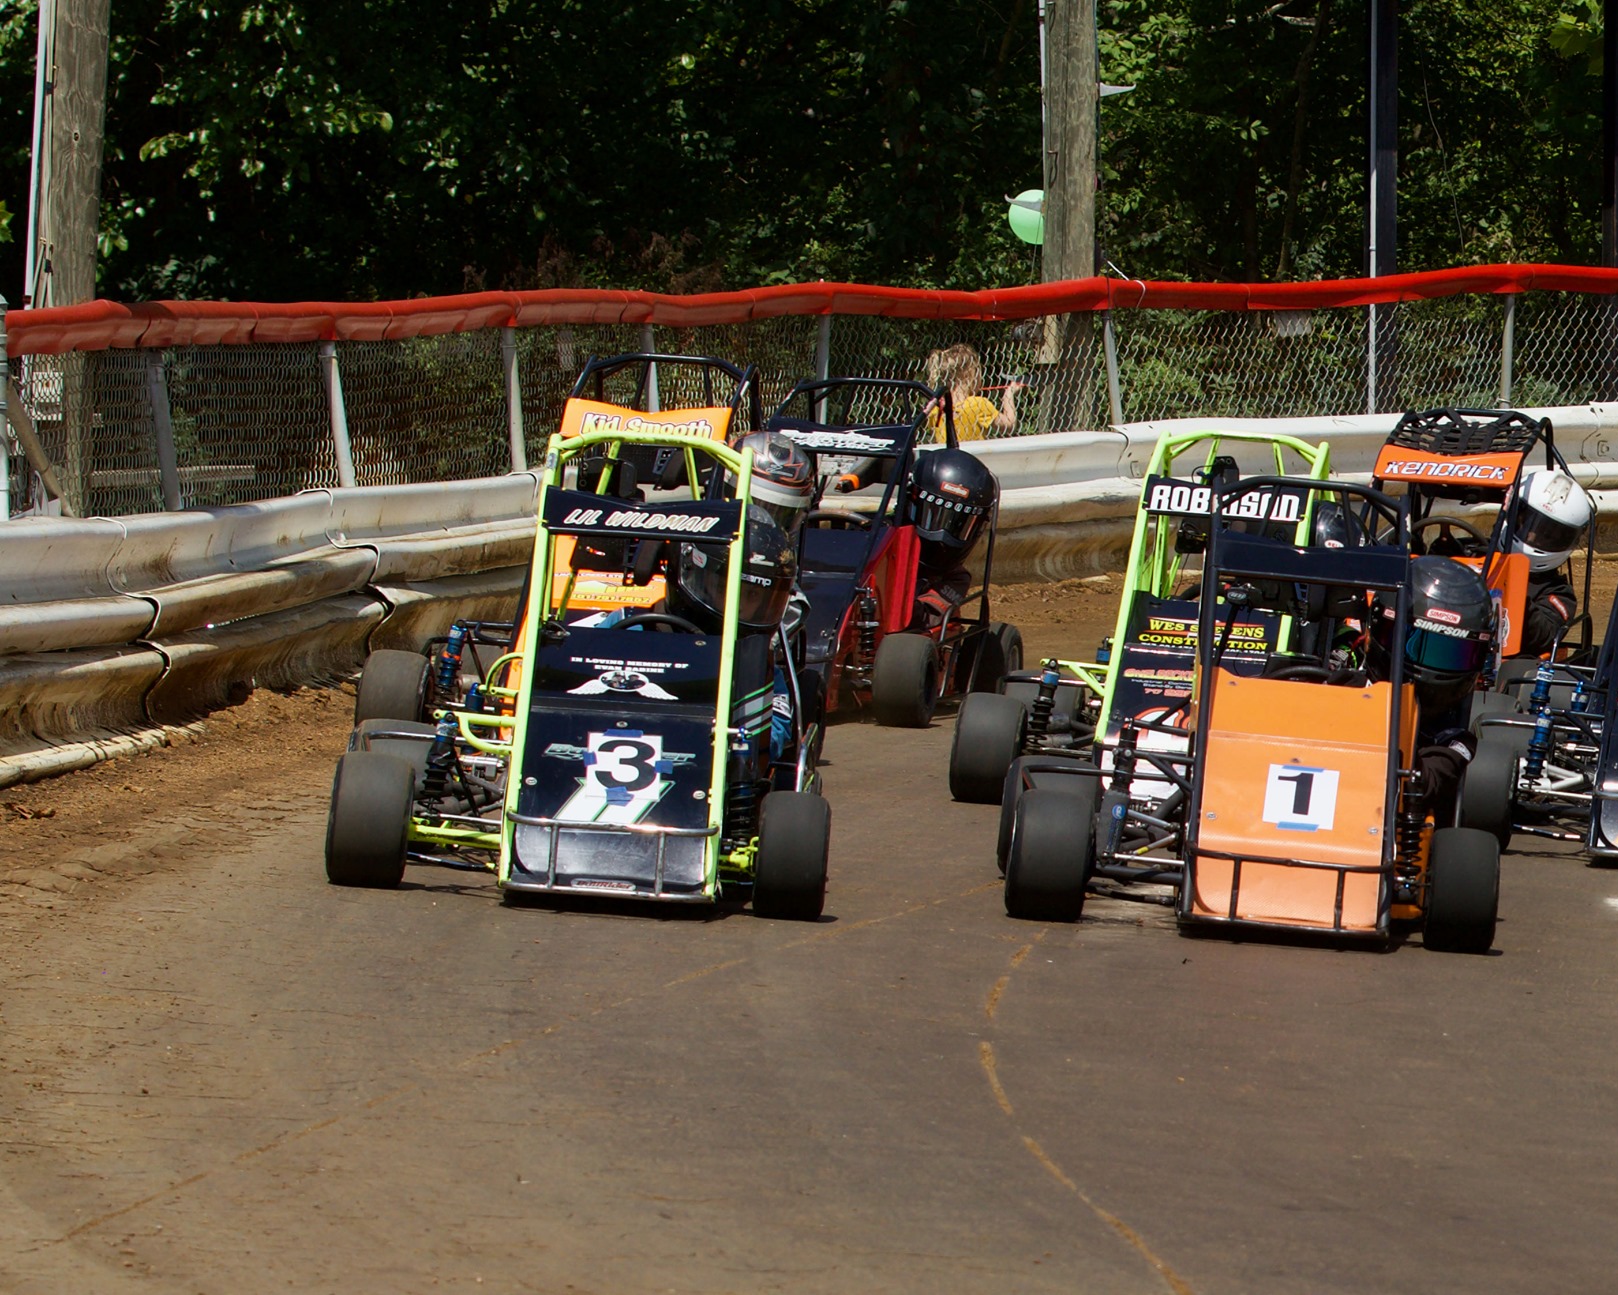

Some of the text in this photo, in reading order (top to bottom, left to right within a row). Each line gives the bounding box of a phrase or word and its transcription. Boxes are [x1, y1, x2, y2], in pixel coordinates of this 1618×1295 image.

[581, 412, 713, 439] Kid Smooth
[564, 508, 721, 533] LIL WILDMAN
[1149, 619, 1185, 632] WES
[1413, 618, 1470, 639] SIMPSON
[1429, 610, 1461, 624] SIMPSON
[594, 739, 657, 792] 3
[1277, 772, 1315, 816] 1
